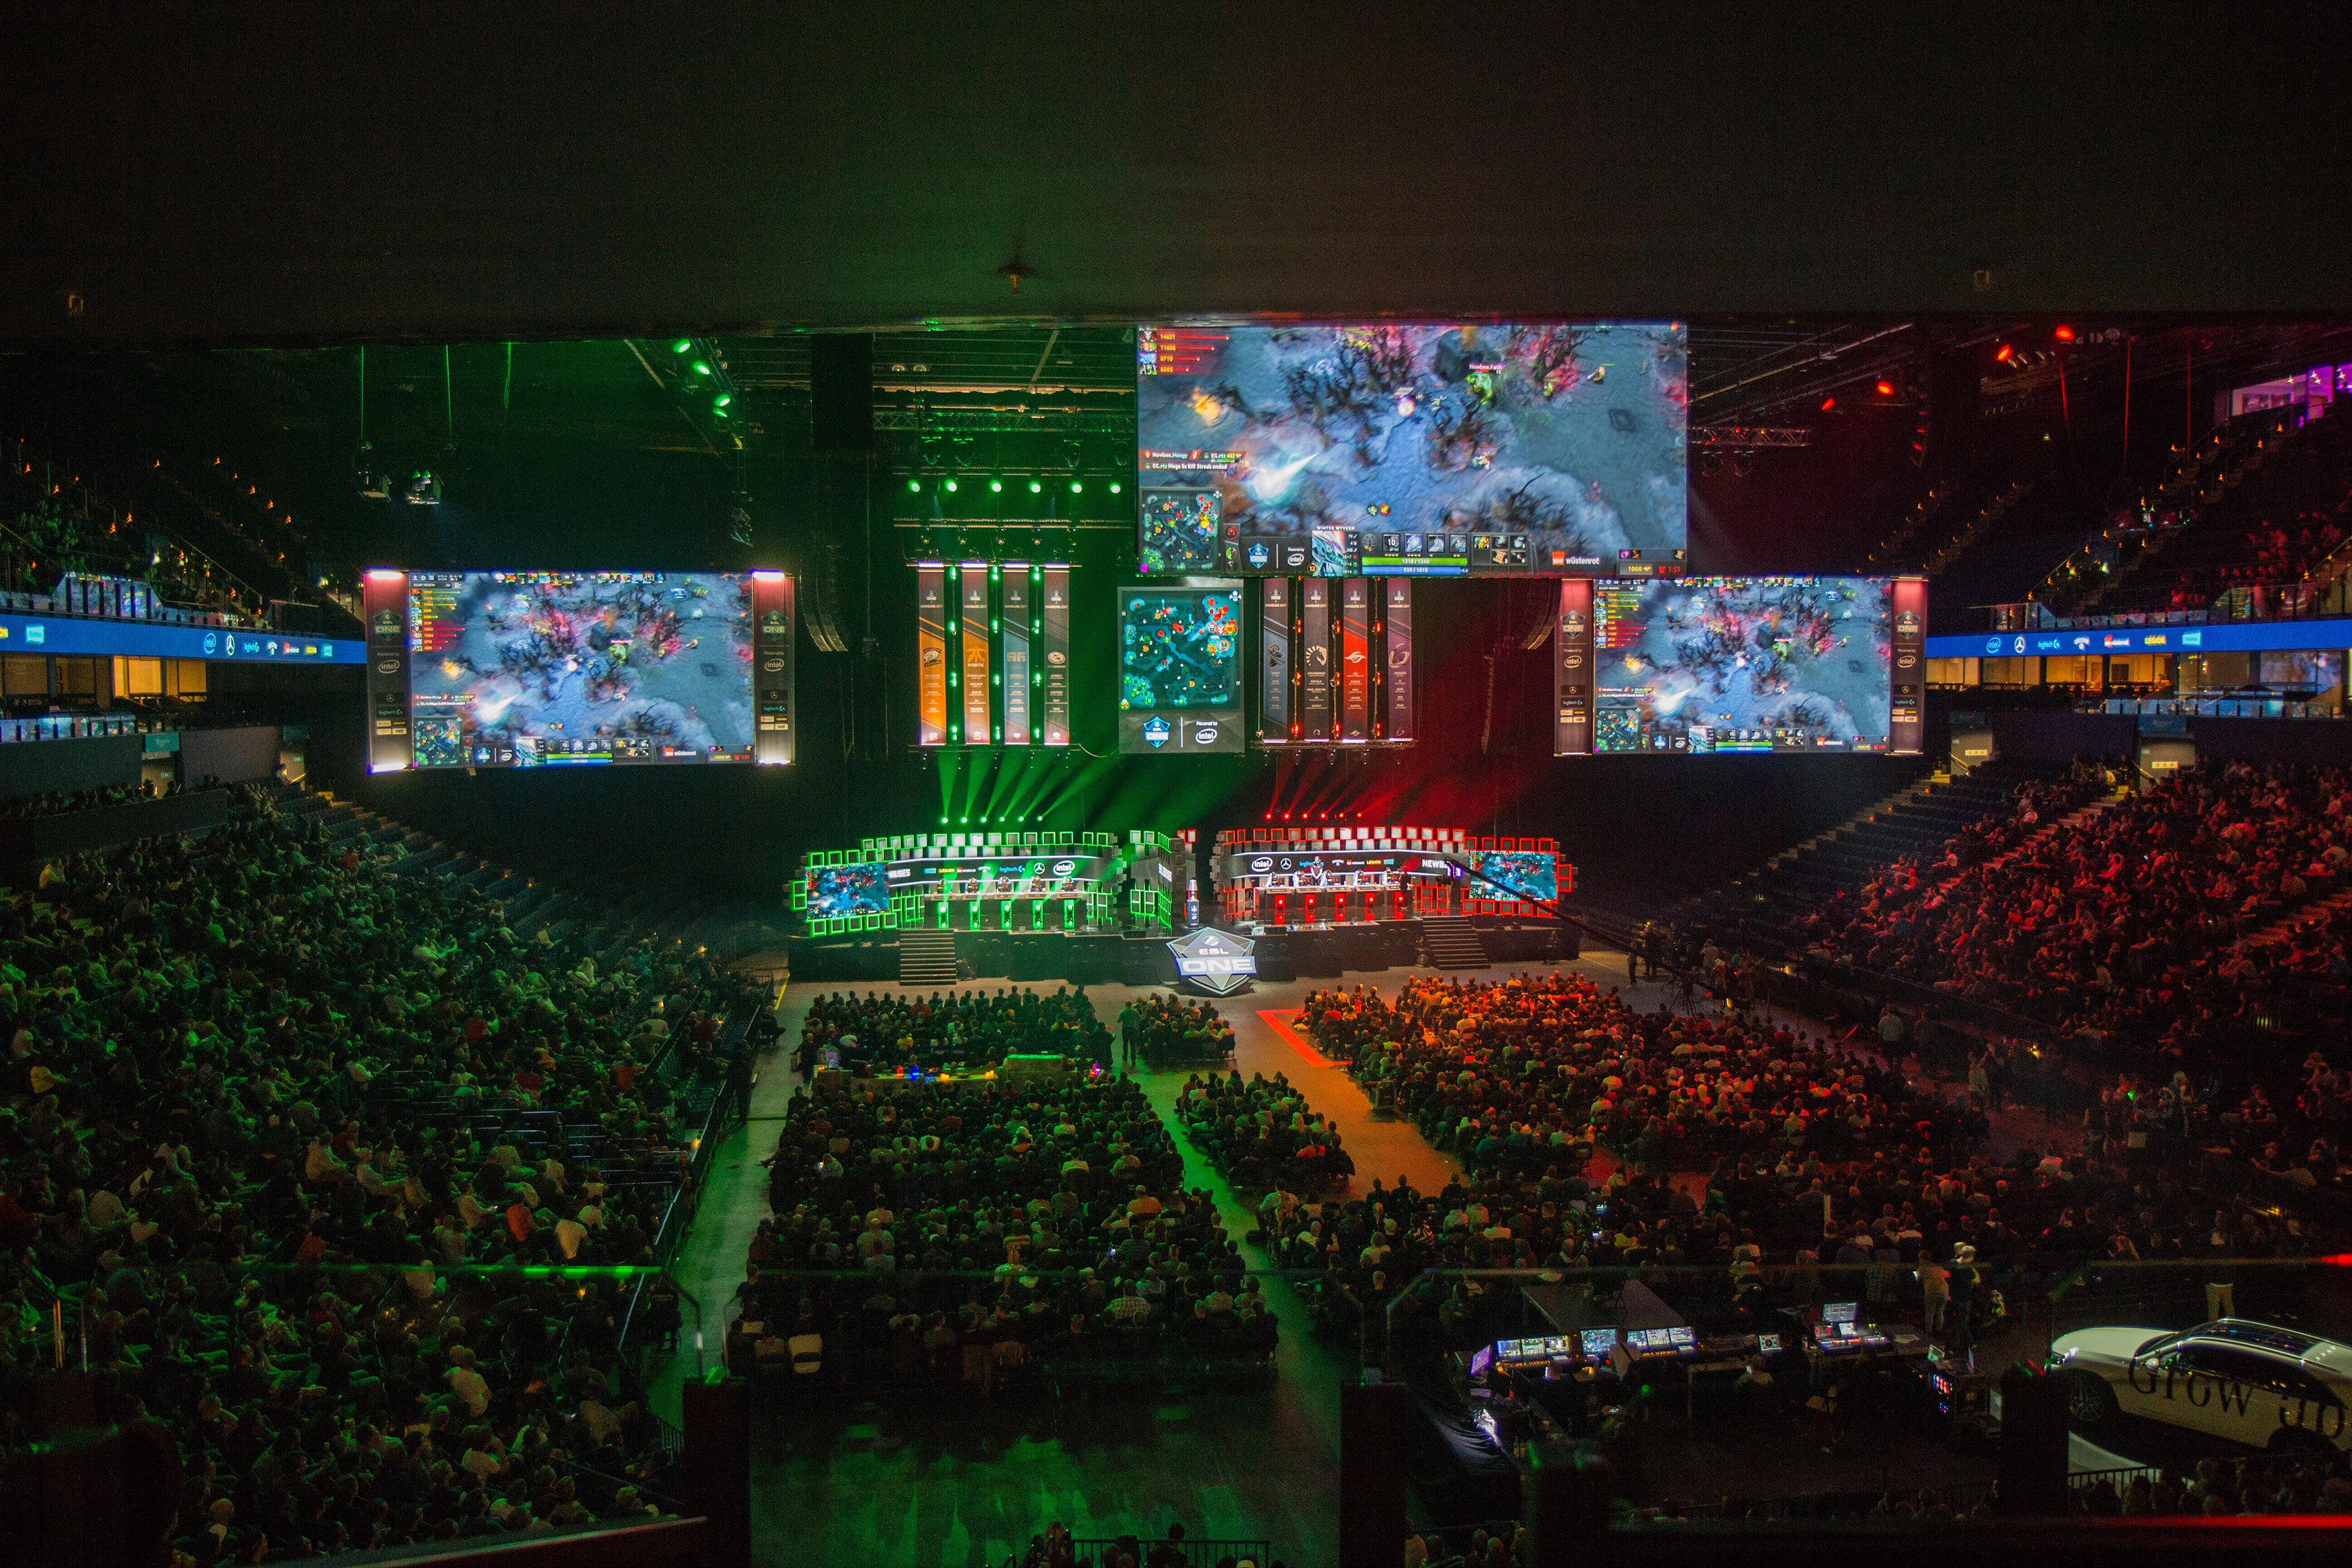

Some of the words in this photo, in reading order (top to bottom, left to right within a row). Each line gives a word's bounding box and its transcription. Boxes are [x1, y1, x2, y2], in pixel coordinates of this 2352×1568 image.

[1566, 556, 1600, 564] wüstenrot
[206, 638, 214, 647] intel
[2145, 636, 2166, 644] LEGION
[2038, 641, 2052, 650] logitech
[1422, 859, 1448, 868] NEWB
[1182, 959, 1253, 972] ONE
[2128, 1355, 2254, 1416] Grow
